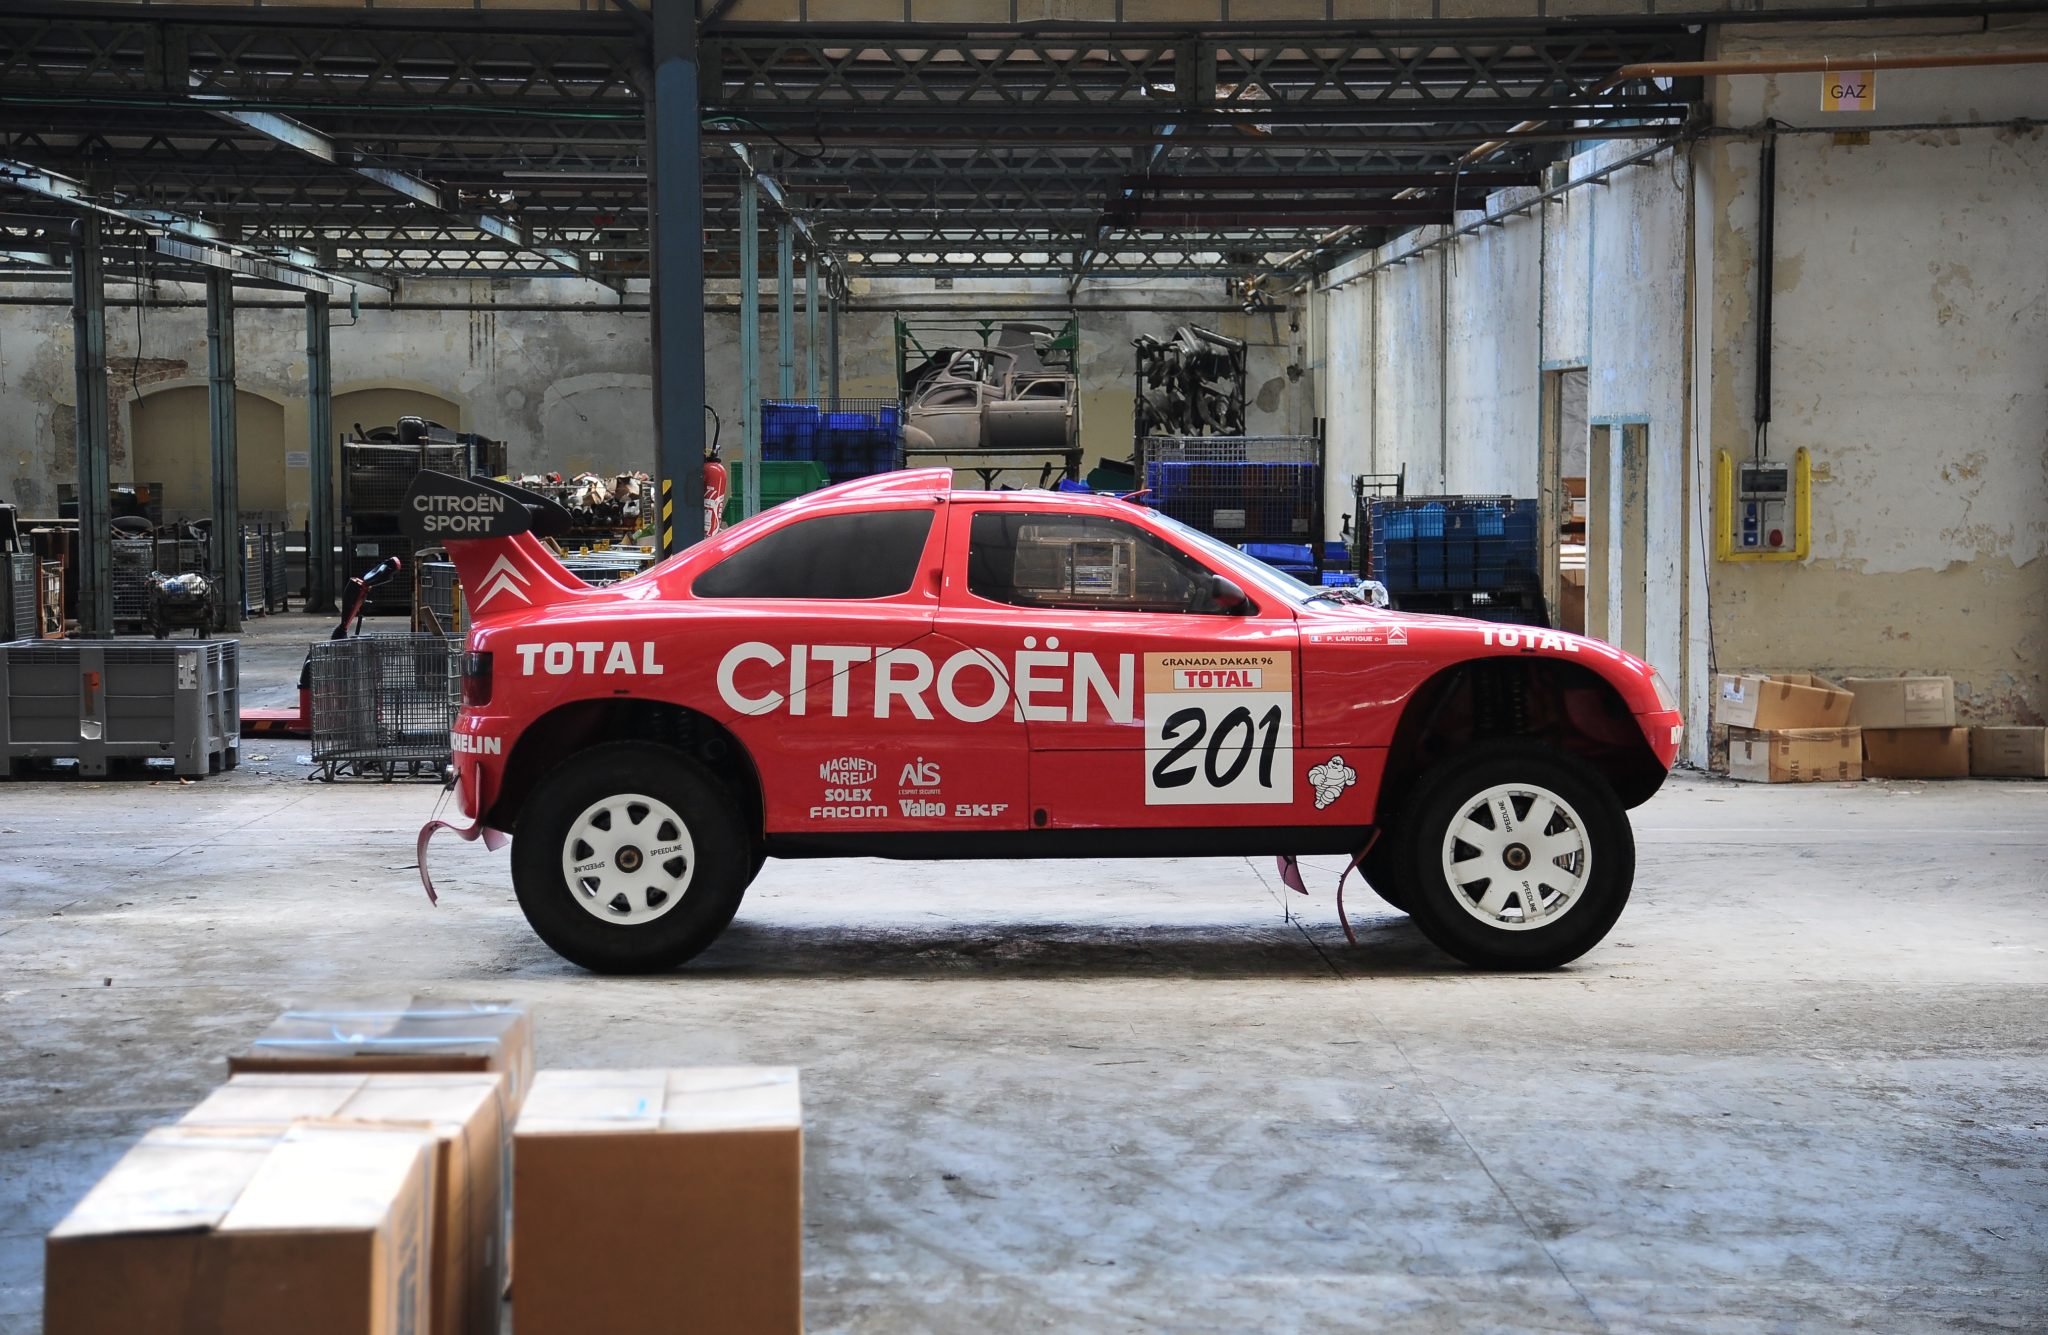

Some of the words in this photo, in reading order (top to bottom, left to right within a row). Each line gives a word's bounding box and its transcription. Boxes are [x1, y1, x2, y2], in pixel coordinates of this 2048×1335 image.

[1830, 84, 1867, 99] GAZ
[413, 493, 505, 513] CITROËN
[423, 515, 494, 532] SPORT
[1478, 626, 1580, 652] TOTAL
[516, 641, 664, 677] TOTAL
[1161, 658, 1217, 667] GRANADA
[1220, 657, 1259, 667] DAKAR
[1261, 657, 1274, 666] 96
[716, 635, 1136, 724] CITROËN
[1184, 670, 1253, 688] TOTAL
[450, 731, 501, 755] CHELIN
[1152, 704, 1282, 789] 201
[825, 788, 872, 802] SOLEX
[810, 805, 888, 819] FACOM
[899, 799, 946, 817] Valeo
[955, 803, 1009, 817] SKF
[1497, 799, 1513, 833] SPEEDLINE
[650, 844, 683, 857] SPEEDLINE
[573, 861, 606, 874] SPEEDLINE
[1521, 880, 1538, 913] SPEEDLINE
